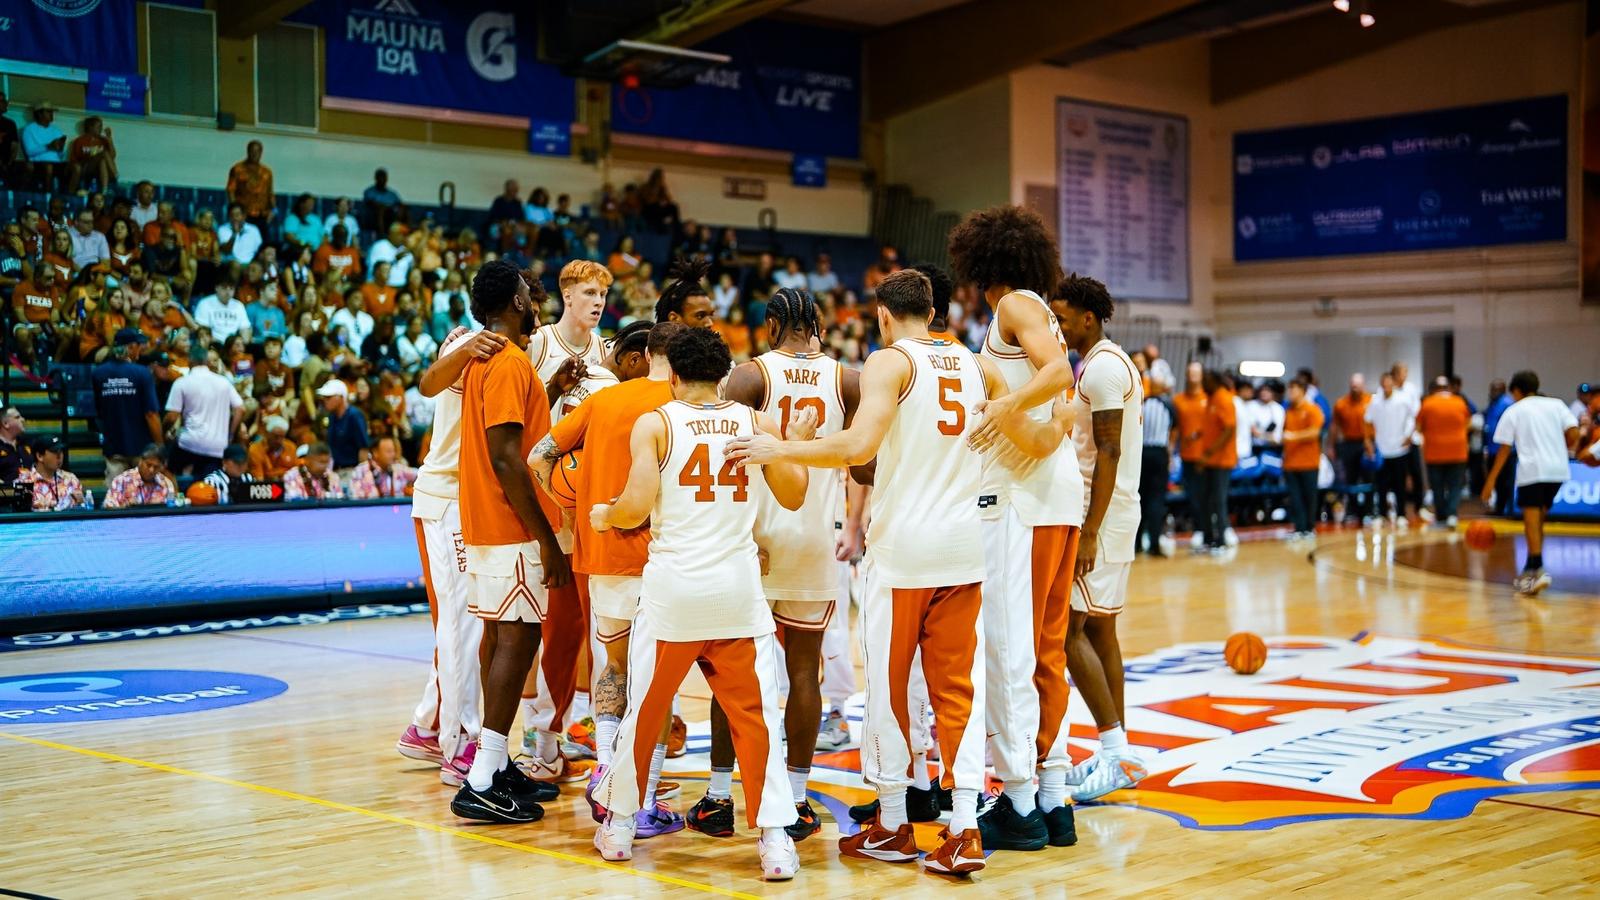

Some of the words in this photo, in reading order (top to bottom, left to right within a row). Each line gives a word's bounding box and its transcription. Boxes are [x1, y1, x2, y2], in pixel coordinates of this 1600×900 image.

[346, 14, 447, 54] MAUNA
[466, 11, 518, 82] G
[776, 84, 836, 111] LIVE
[25, 294, 53, 309] TEXAS
[783, 368, 822, 386] MARK
[937, 376, 966, 436] 5
[685, 419, 740, 437] TAYLOR
[679, 443, 750, 502] 44
[250, 484, 273, 500] POSS
[452, 529, 467, 573] TEXAS
[0, 686, 249, 721] Principal
[1426, 716, 1600, 773] CHAMINA
